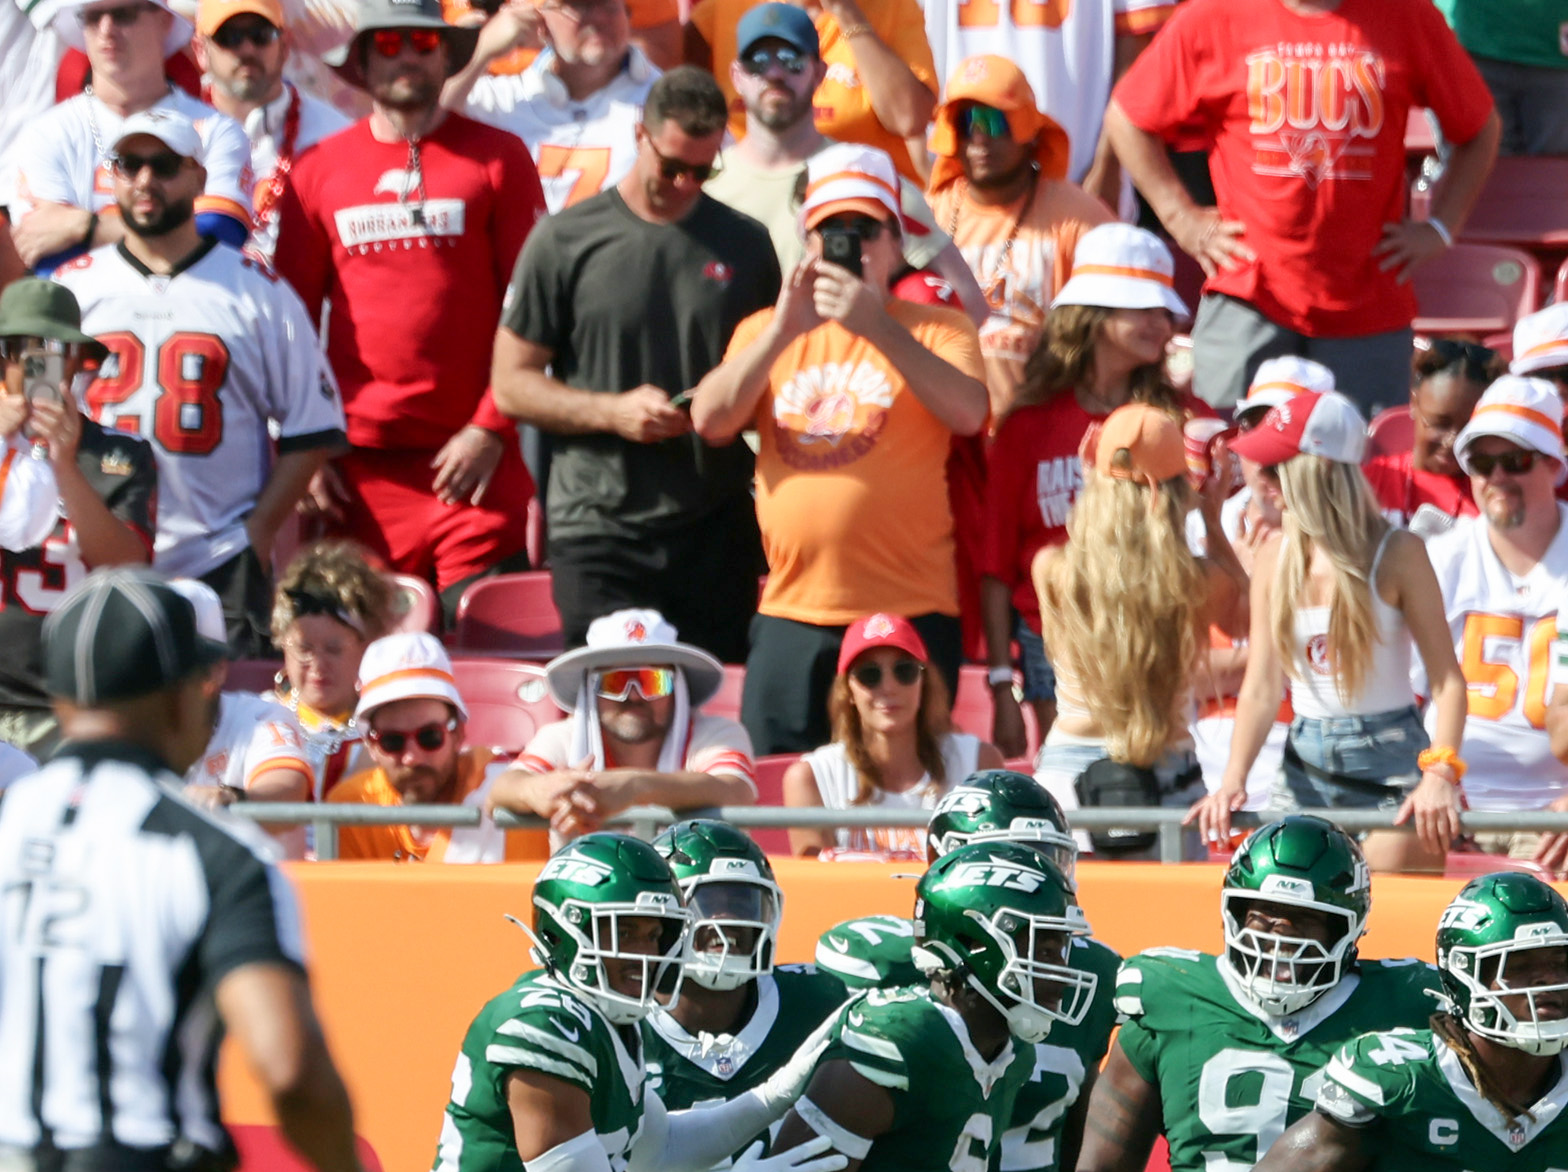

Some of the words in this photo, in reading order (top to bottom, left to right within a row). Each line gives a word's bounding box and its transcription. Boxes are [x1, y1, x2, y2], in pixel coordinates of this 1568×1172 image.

[1245, 54, 1386, 139] BUCS
[84, 330, 230, 456] 28
[1037, 455, 1084, 492] RAIS
[726, 859, 748, 869] NY
[931, 853, 1048, 893] JETS
[1275, 879, 1304, 890] NY
[1000, 1042, 1086, 1172] 2
[1427, 1117, 1460, 1147] C
